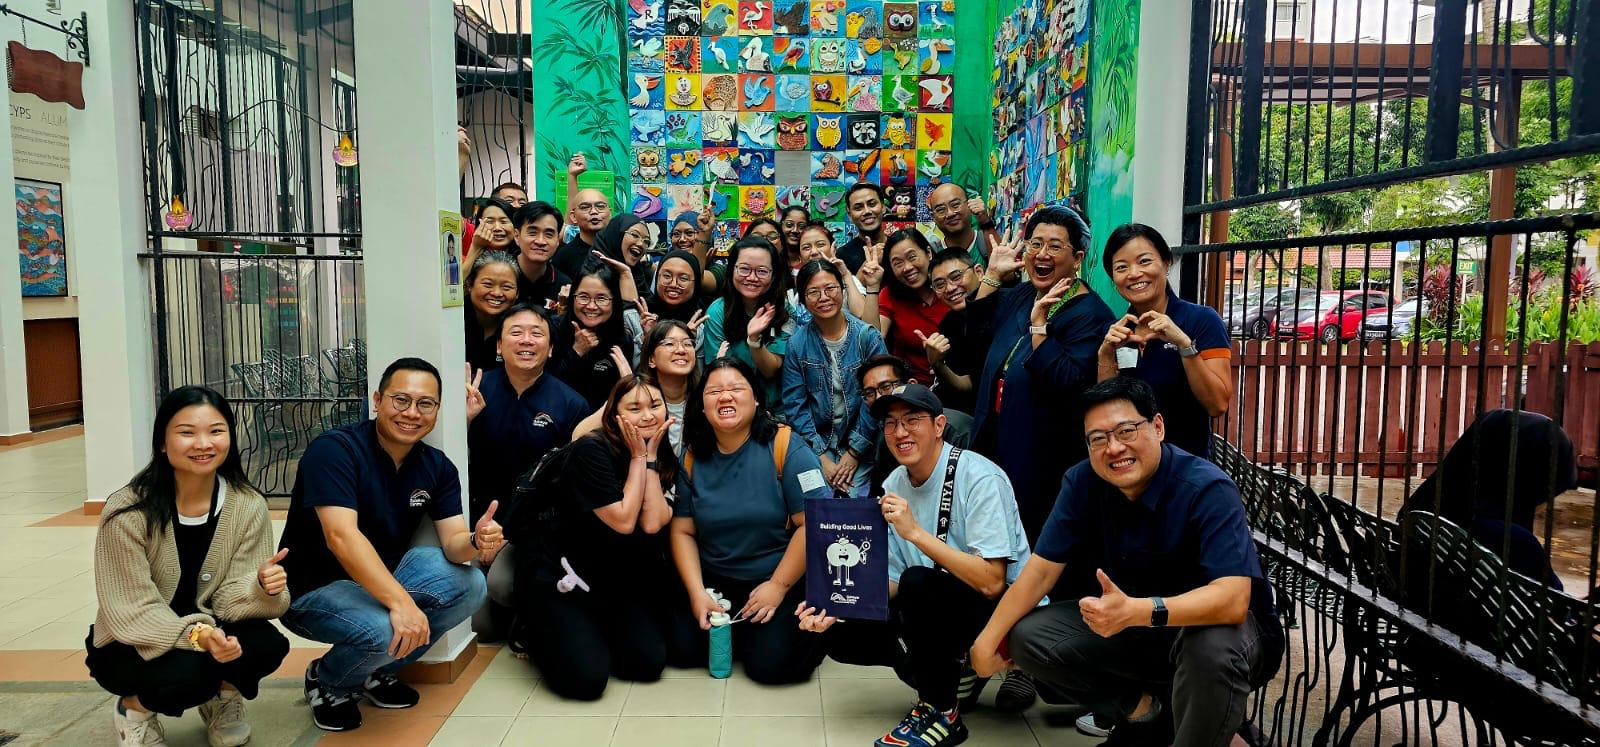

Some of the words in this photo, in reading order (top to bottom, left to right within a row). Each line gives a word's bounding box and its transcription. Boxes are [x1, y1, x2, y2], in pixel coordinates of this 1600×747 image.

[645, 9, 653, 20] R
[1459, 261, 1474, 270] EXIT
[941, 479, 954, 512] HIYA
[819, 523, 841, 531] Building
[857, 523, 872, 531] Lives
